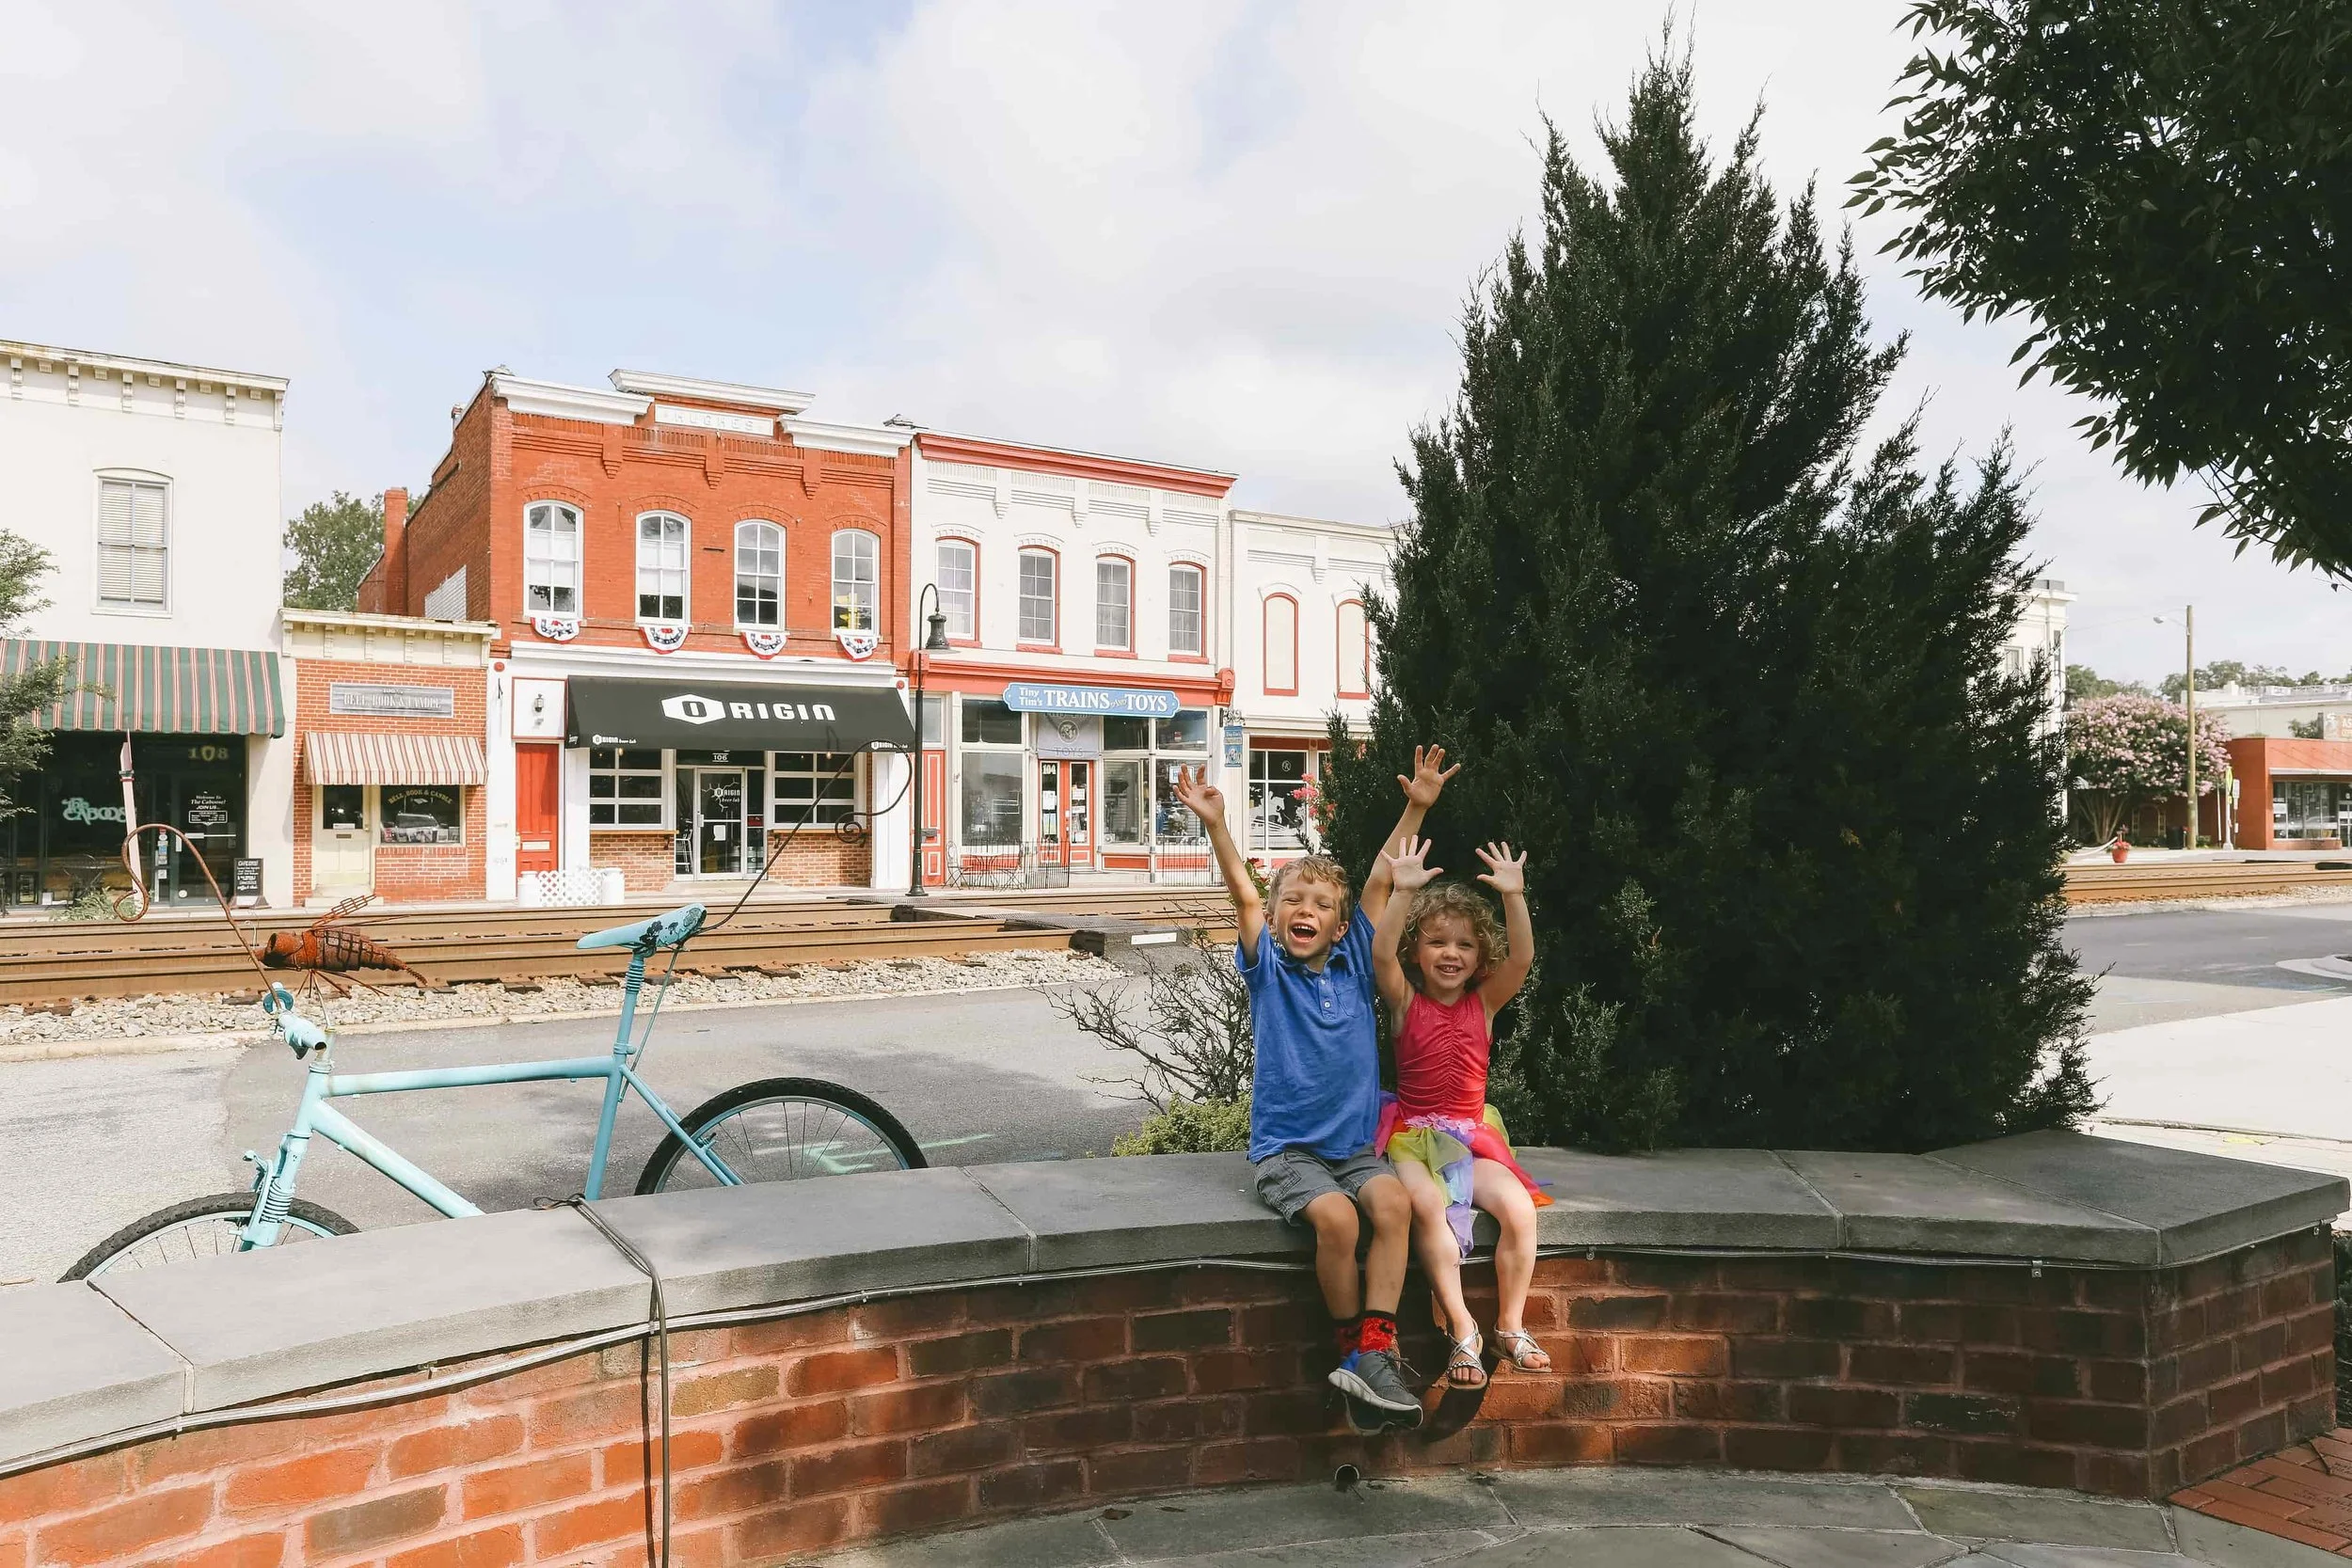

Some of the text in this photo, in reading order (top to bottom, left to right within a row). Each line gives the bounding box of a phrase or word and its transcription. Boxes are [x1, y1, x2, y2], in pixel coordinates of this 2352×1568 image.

[674, 414, 754, 431] HUGHES
[1019, 687, 1040, 697] Tiny
[1019, 696, 1042, 706] Tim's
[1043, 689, 1111, 709] TRAINS
[1124, 693, 1168, 712] TOYS
[188, 745, 229, 762] 108
[1053, 747, 1084, 757] TOYS
[1042, 764, 1057, 775] 104
